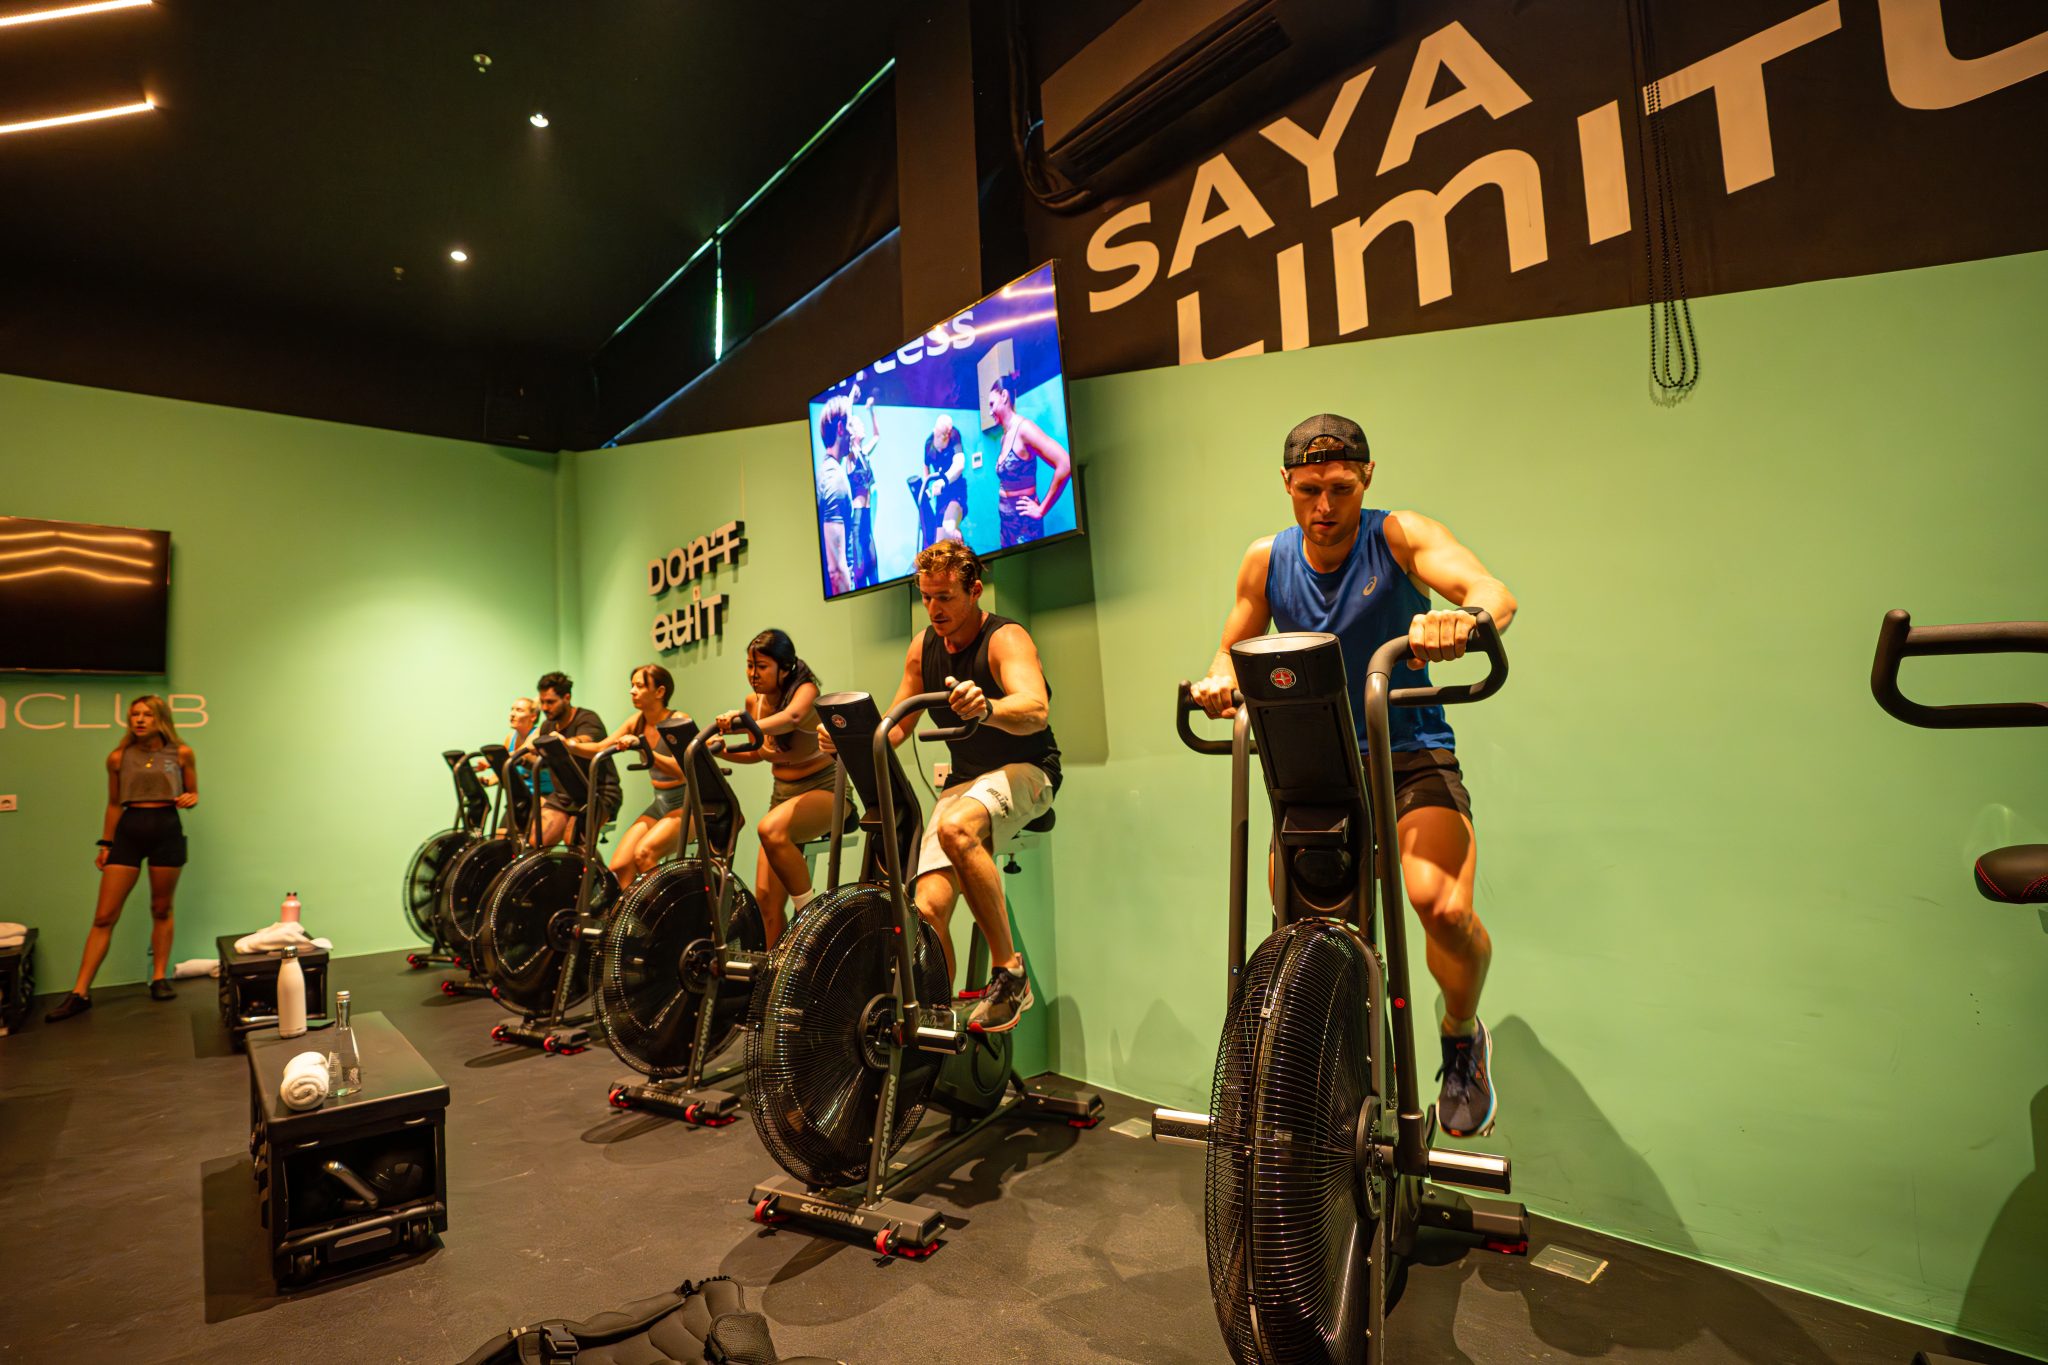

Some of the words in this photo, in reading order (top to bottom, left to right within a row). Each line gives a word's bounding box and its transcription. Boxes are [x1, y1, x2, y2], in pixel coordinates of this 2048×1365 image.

[1087, 20, 1532, 313] SAYA
[879, 1074, 896, 1176] SCHWINN
[800, 1203, 865, 1226] SCHWINN
